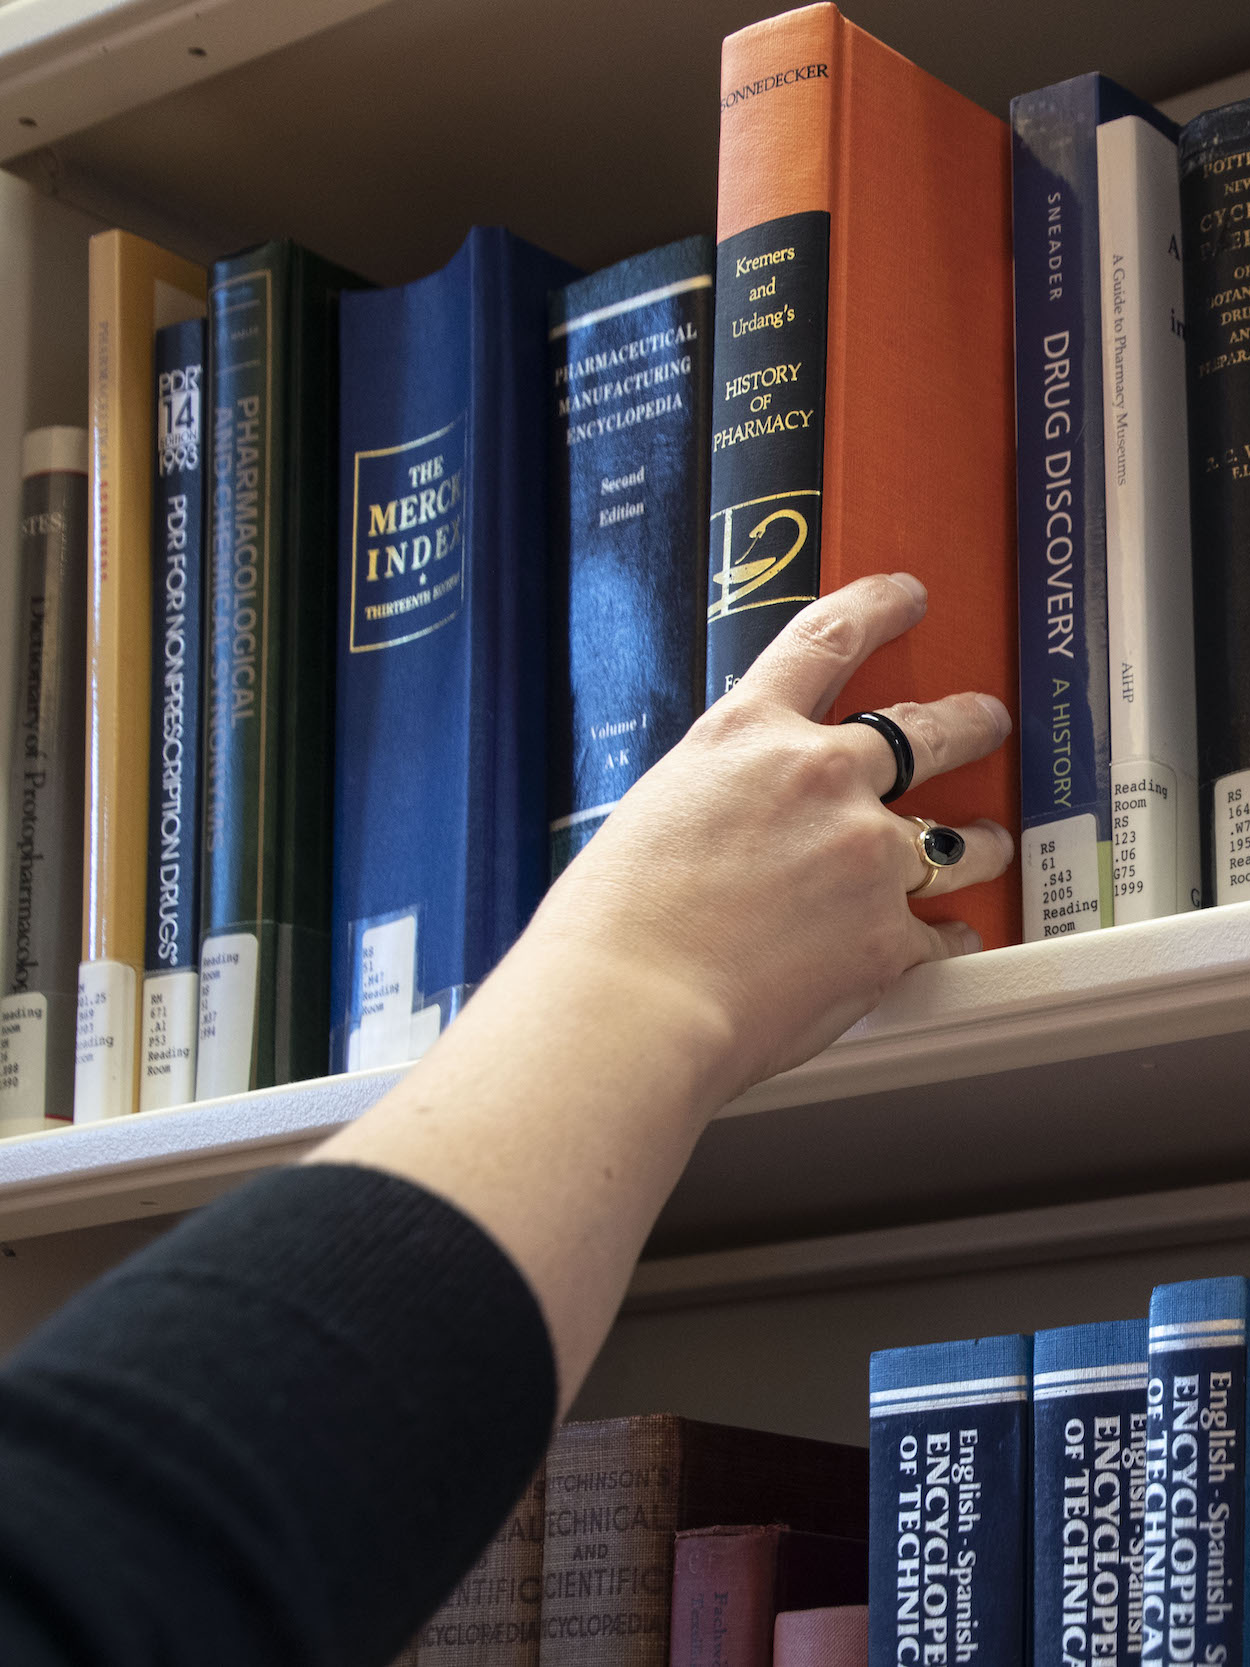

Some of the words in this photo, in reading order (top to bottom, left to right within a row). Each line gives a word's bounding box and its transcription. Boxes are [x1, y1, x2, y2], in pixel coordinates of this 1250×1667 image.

[735, 246, 796, 278] Kremers
[1047, 192, 1063, 301] SNEADER
[1112, 253, 1125, 266] A
[749, 277, 776, 302] and
[1112, 267, 1126, 319] Guide
[732, 305, 796, 339] Urdang's
[1113, 320, 1124, 333] to
[555, 322, 698, 387] PHARMACEUTICAL
[559, 355, 692, 417] MANUFACTURING
[725, 362, 802, 402] HISTORY
[1043, 330, 1071, 441] DRUG
[1111, 335, 1128, 410] Pharmacy
[162, 395, 195, 435] 14
[566, 392, 683, 447] ENCYCLOPEDIA
[749, 395, 772, 414] OF
[712, 409, 815, 454] PHARMACY
[158, 443, 198, 478] 1993
[1116, 413, 1129, 487] Museums
[408, 454, 444, 488] THE
[601, 465, 646, 496] Second
[368, 470, 462, 538] MERCK
[599, 499, 645, 528] Edition
[167, 494, 187, 550] PDR
[230, 394, 260, 729] PHARMACOLOGICAL
[366, 514, 461, 582] INDEX
[1044, 450, 1075, 659] DISCOVERY
[165, 552, 187, 612] FOR
[364, 589, 432, 621] THIRTEENTH
[1052, 678, 1070, 698] A
[1121, 661, 1135, 703] AIHP
[160, 613, 186, 863] NONPRESCRIPTION
[590, 717, 637, 741] Volume
[604, 749, 630, 770] A-K
[1053, 703, 1072, 808] HISTORY
[1114, 779, 1168, 799] Reading
[1114, 798, 1147, 812] Room
[1228, 788, 1242, 803] RS
[1114, 815, 1129, 829] RS
[1229, 803, 1250, 819] 164
[1040, 840, 1056, 855] RS
[1114, 831, 1136, 846] 123
[1041, 857, 1055, 871] 61
[1113, 864, 1136, 880] G75
[1115, 848, 1136, 863] .U6
[1043, 869, 1072, 887] .S43
[1114, 880, 1144, 897] 1999
[1043, 886, 1073, 904] 2005
[1043, 898, 1098, 921] Reading
[1044, 920, 1076, 937] Room
[362, 982, 400, 1000] Reading
[147, 1046, 191, 1062] Reading
[147, 1063, 171, 1077] Room
[1147, 1376, 1165, 1423] OF
[1064, 1418, 1085, 1460] OF
[1200, 1370, 1236, 1484] English
[899, 1434, 919, 1476] OF
[951, 1428, 982, 1533] English
[572, 1543, 609, 1562] AND
[1200, 1501, 1233, 1624] Spanish
[950, 1549, 979, 1663] Spanish
